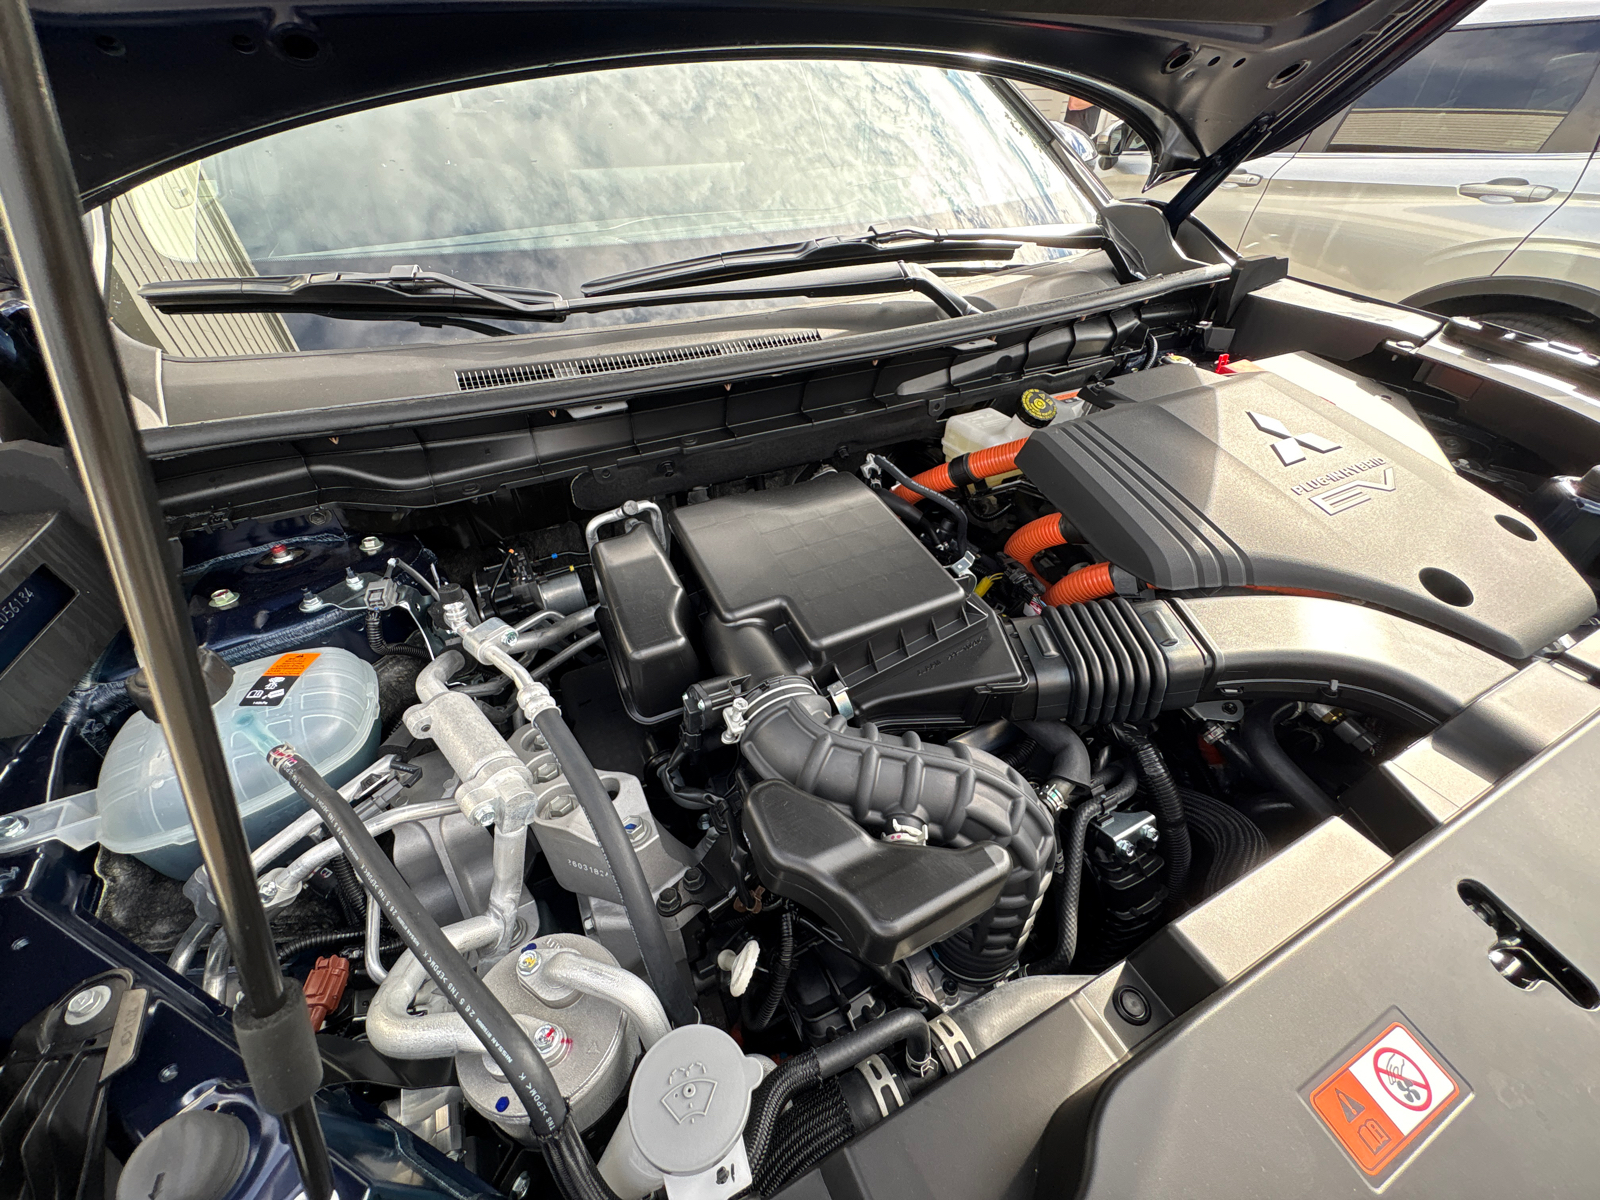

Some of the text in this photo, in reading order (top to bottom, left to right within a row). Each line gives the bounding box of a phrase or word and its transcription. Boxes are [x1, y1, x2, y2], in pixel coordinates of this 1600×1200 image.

[1308, 467, 1396, 516] EV
[0, 587, 34, 630] 056134
[491, 1037, 512, 1063] NISSAN
